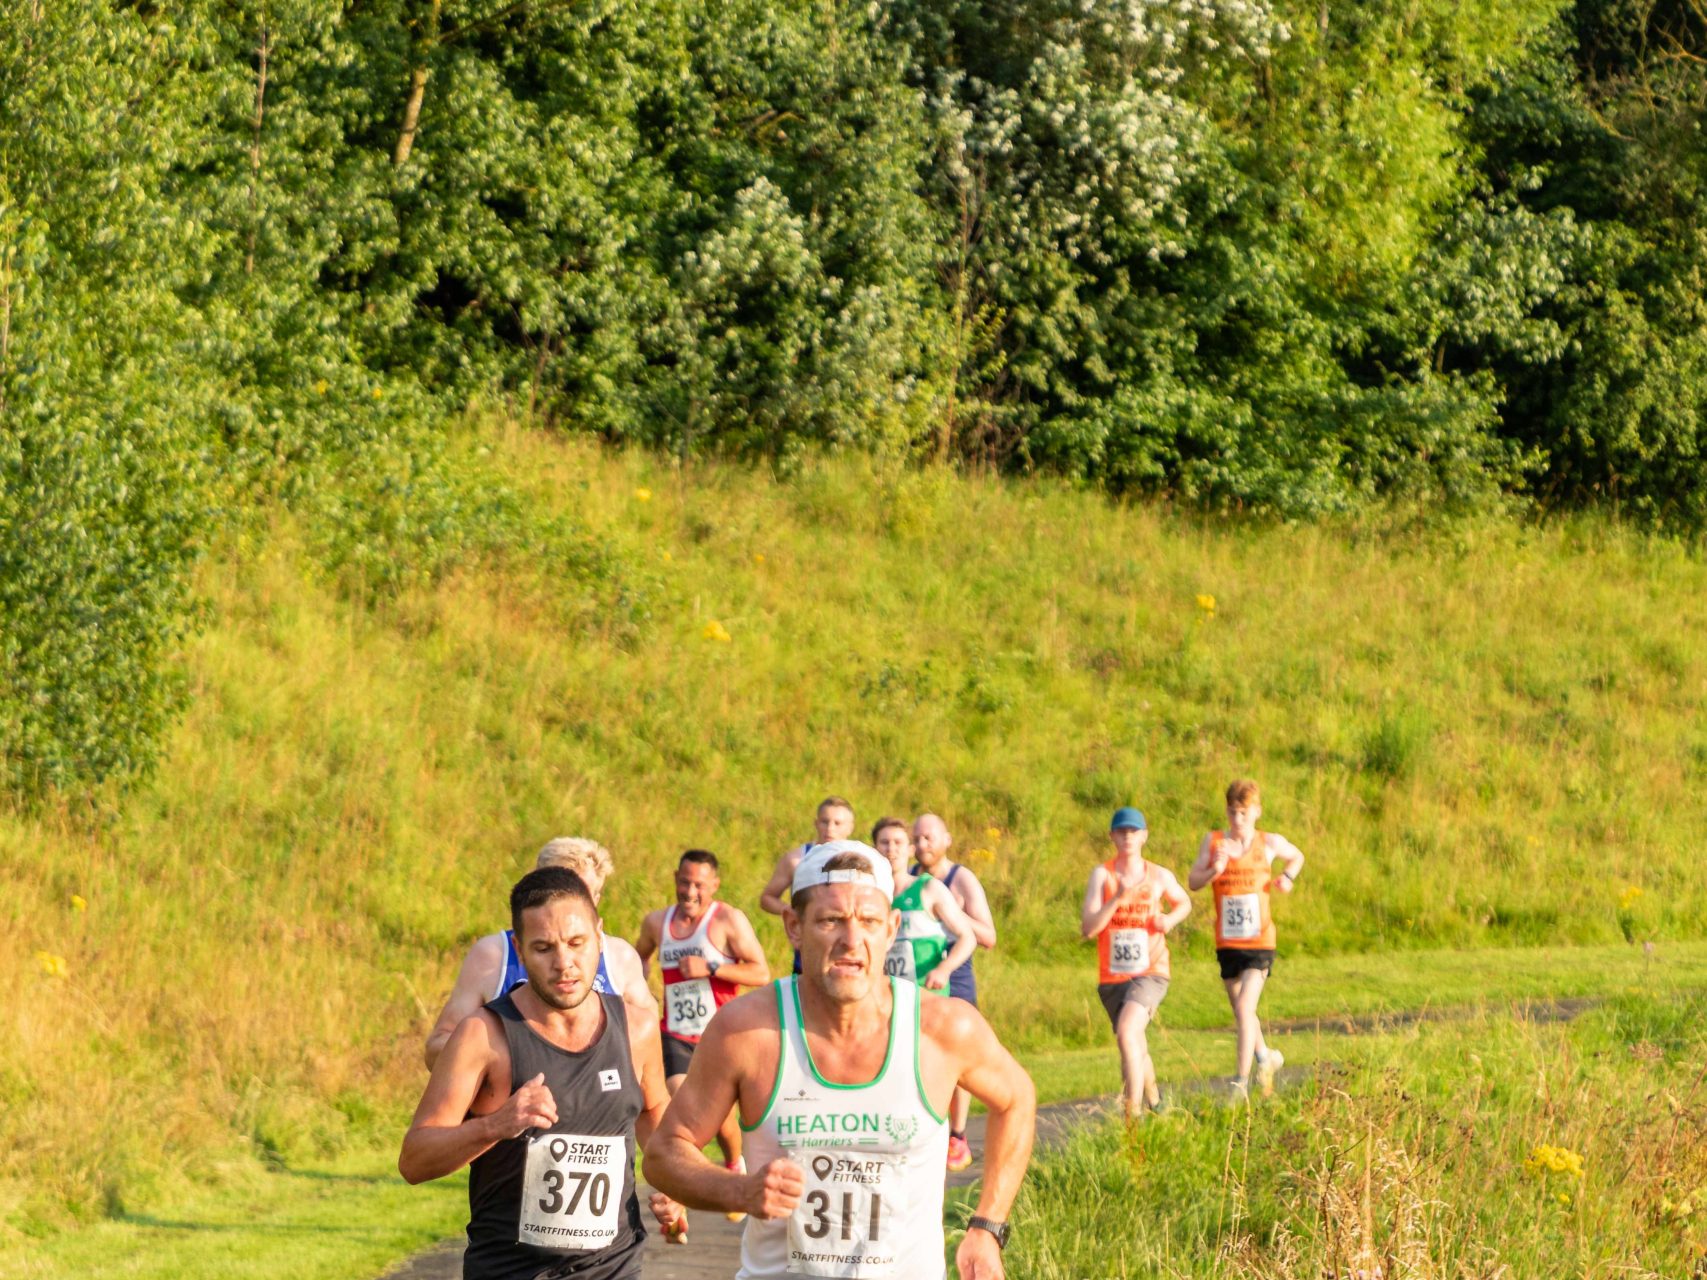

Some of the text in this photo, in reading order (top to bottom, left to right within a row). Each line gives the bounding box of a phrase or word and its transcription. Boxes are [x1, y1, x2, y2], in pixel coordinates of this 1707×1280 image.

[1114, 944, 1141, 961] 383
[673, 996, 707, 1022] 336
[777, 1113, 879, 1135] HEATON
[802, 1136, 853, 1147] Harriers
[570, 1142, 611, 1156] START
[567, 1155, 608, 1165] FITNESS
[835, 1159, 885, 1173] START
[832, 1172, 881, 1184] FITNESS
[539, 1169, 610, 1217] 370
[804, 1189, 881, 1241] 311
[523, 1223, 615, 1237] STARTFITNESS.CO.UK
